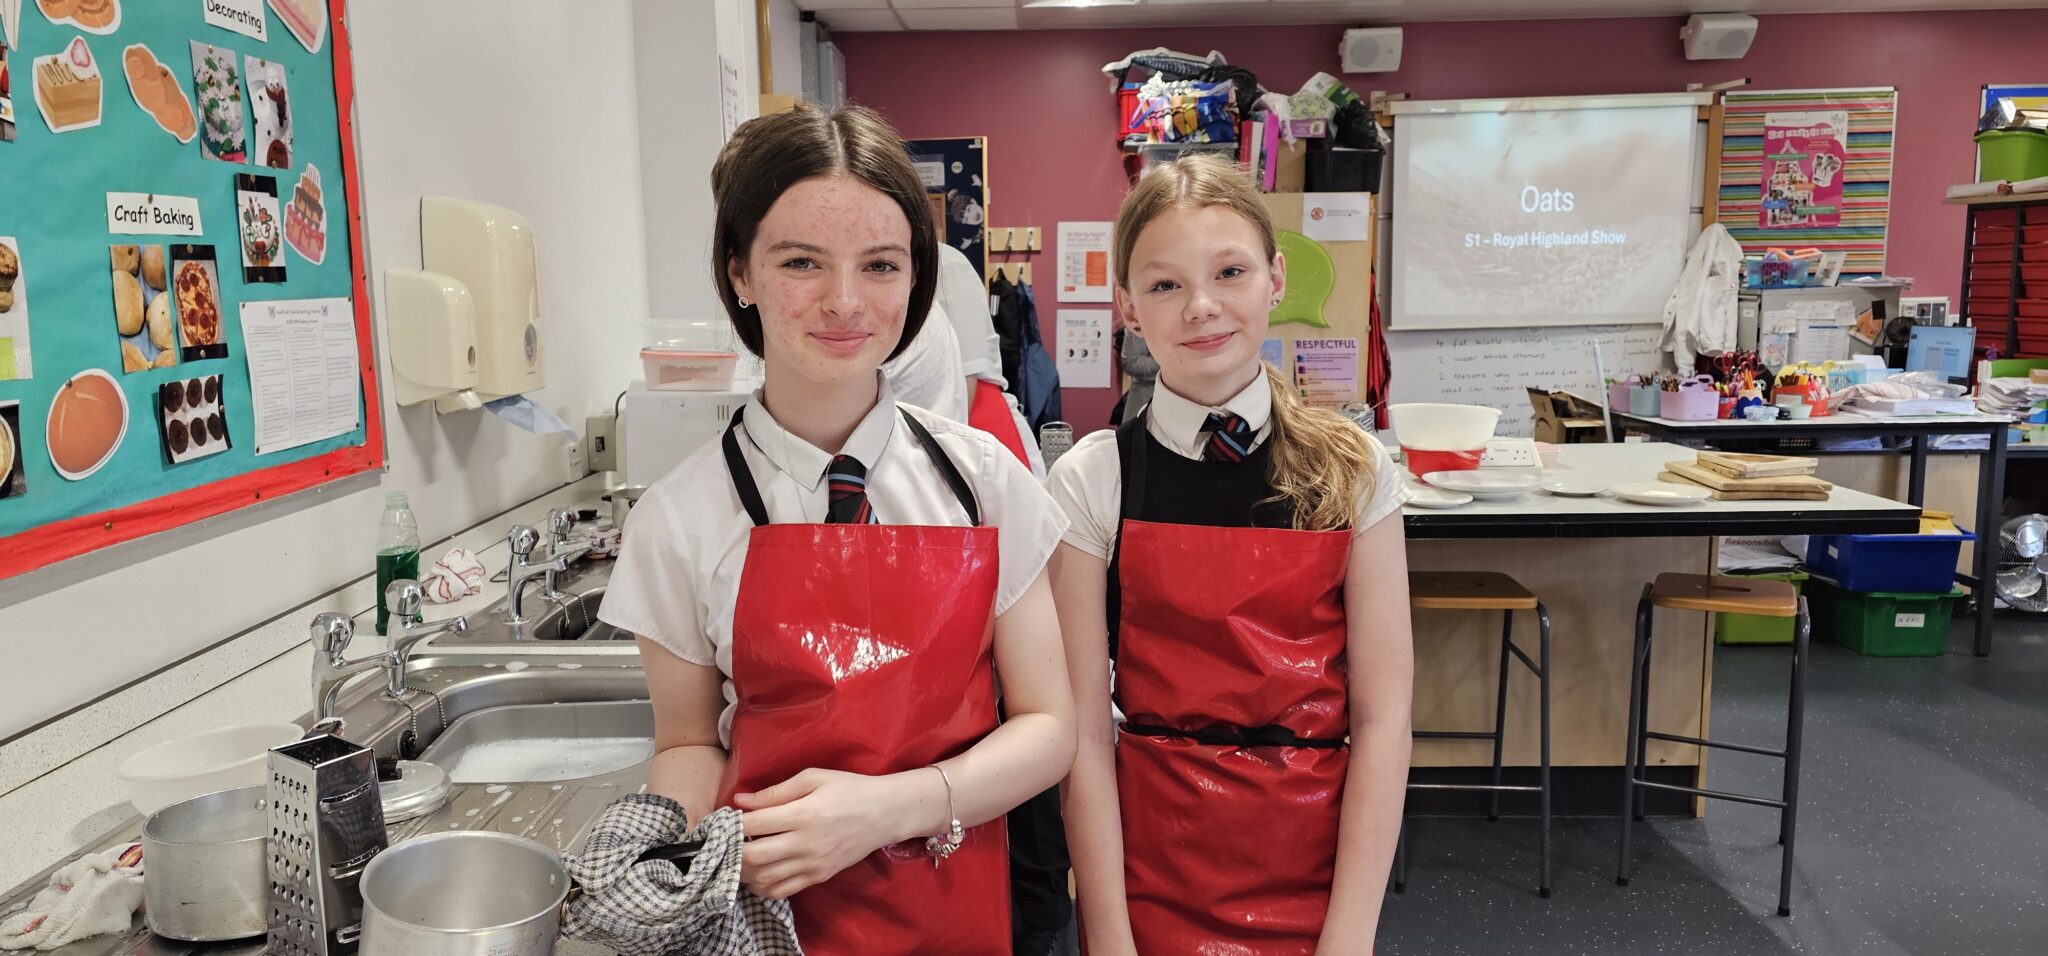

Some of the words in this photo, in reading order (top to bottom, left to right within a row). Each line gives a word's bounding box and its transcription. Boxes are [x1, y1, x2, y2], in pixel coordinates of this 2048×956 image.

[206, 0, 262, 33] Decorating
[1520, 185, 1575, 213] Oats
[114, 205, 148, 224] Craft
[153, 207, 194, 231] Baking
[1464, 233, 1481, 248] S1
[1493, 232, 1529, 249] Royal
[1531, 231, 1589, 248] Highland
[1591, 230, 1626, 245] Show
[1295, 339, 1357, 350] RESPECTFUL
